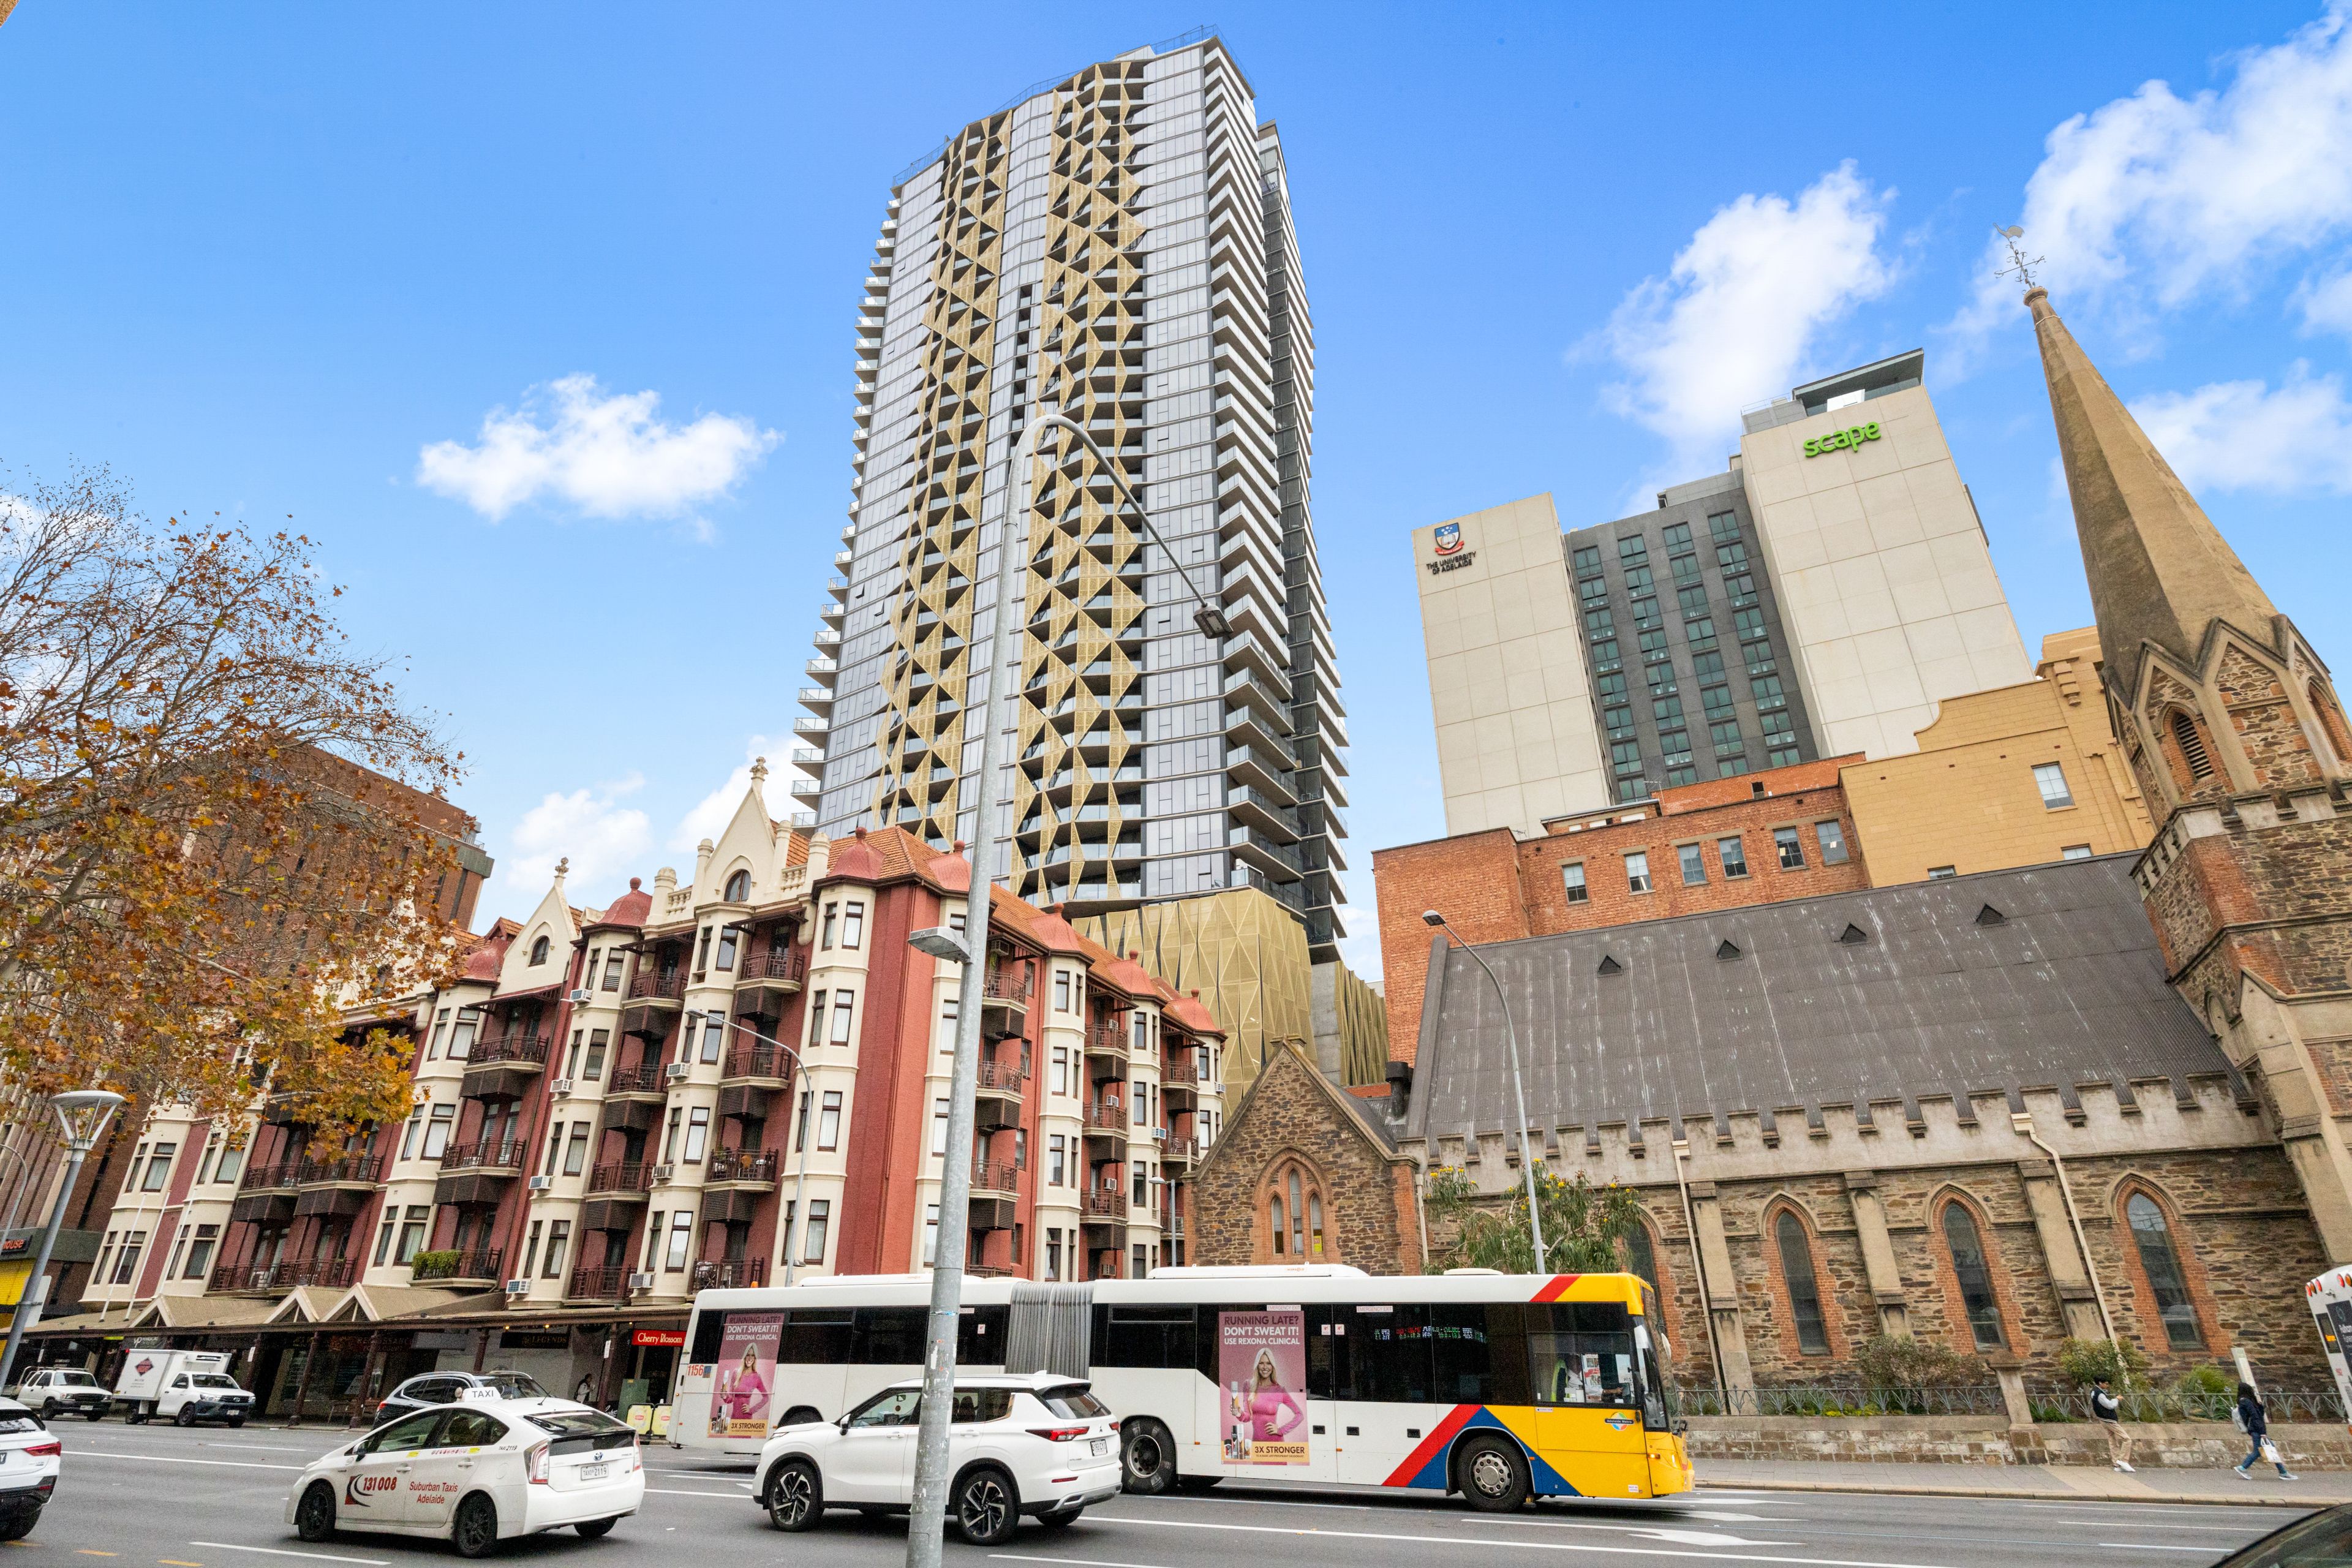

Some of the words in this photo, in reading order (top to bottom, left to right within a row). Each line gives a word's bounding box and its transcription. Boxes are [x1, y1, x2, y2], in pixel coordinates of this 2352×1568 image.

[1803, 421, 1882, 458] scape
[1426, 561, 1439, 570] THE
[1439, 551, 1477, 567] UNIVERSITY
[1441, 559, 1472, 573] ADELAIDE
[1224, 1316, 1269, 1325] RUNNING
[1272, 1315, 1299, 1324] LATE?
[1224, 1327, 1253, 1336] DON'T
[1254, 1327, 1286, 1336] SWEAT
[1287, 1327, 1299, 1335] IT!
[638, 1332, 660, 1345] Cherry
[660, 1333, 682, 1343] Blossom
[688, 1365, 704, 1376] 1156
[471, 1390, 494, 1398] TAXI
[594, 1467, 607, 1476] 2119
[363, 1477, 378, 1491] 131
[377, 1476, 398, 1491] 008
[409, 1481, 440, 1491] Suburban
[442, 1482, 458, 1493] Taxis
[417, 1493, 445, 1504] Adelaide
